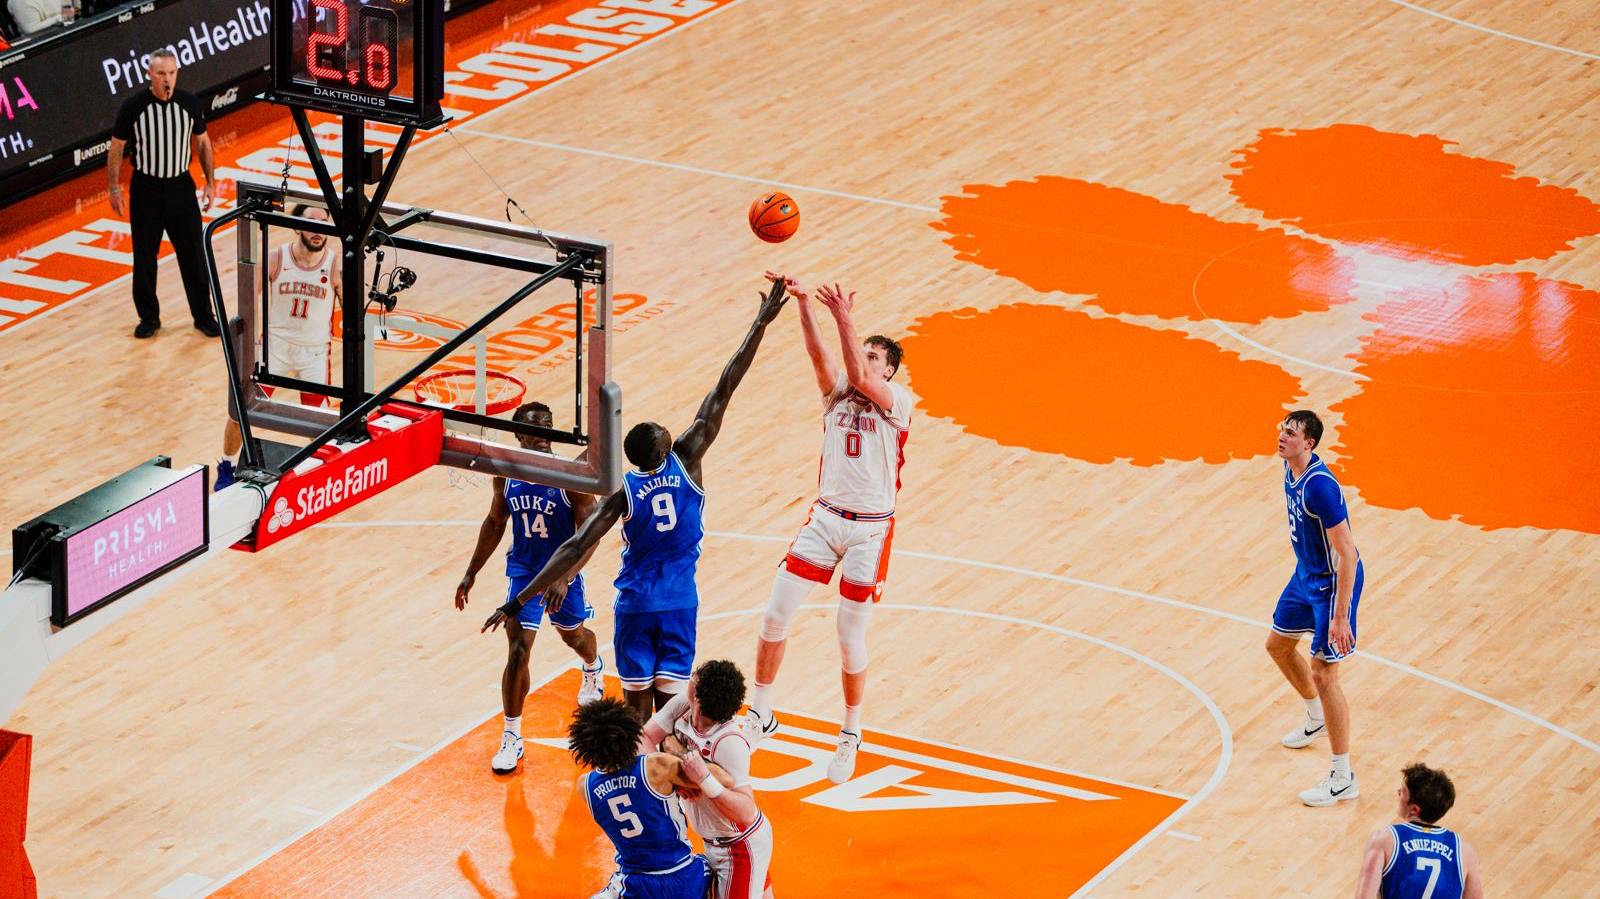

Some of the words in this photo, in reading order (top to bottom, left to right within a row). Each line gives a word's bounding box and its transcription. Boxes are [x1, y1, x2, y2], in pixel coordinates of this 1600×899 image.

[313, 87, 386, 107] DAKTRONICS
[278, 281, 328, 300] CLEMSON
[289, 297, 310, 319] 11
[845, 431, 862, 458] 0
[635, 475, 681, 501] MALUACH
[509, 495, 557, 516] DUKE
[651, 492, 678, 533] 9
[94, 501, 177, 567] PRISMA
[521, 512, 549, 539] 14
[593, 775, 637, 800] PROCTOR
[607, 793, 644, 839] 5
[1402, 838, 1454, 862] KNUEPPEL
[1416, 856, 1442, 899] 7
